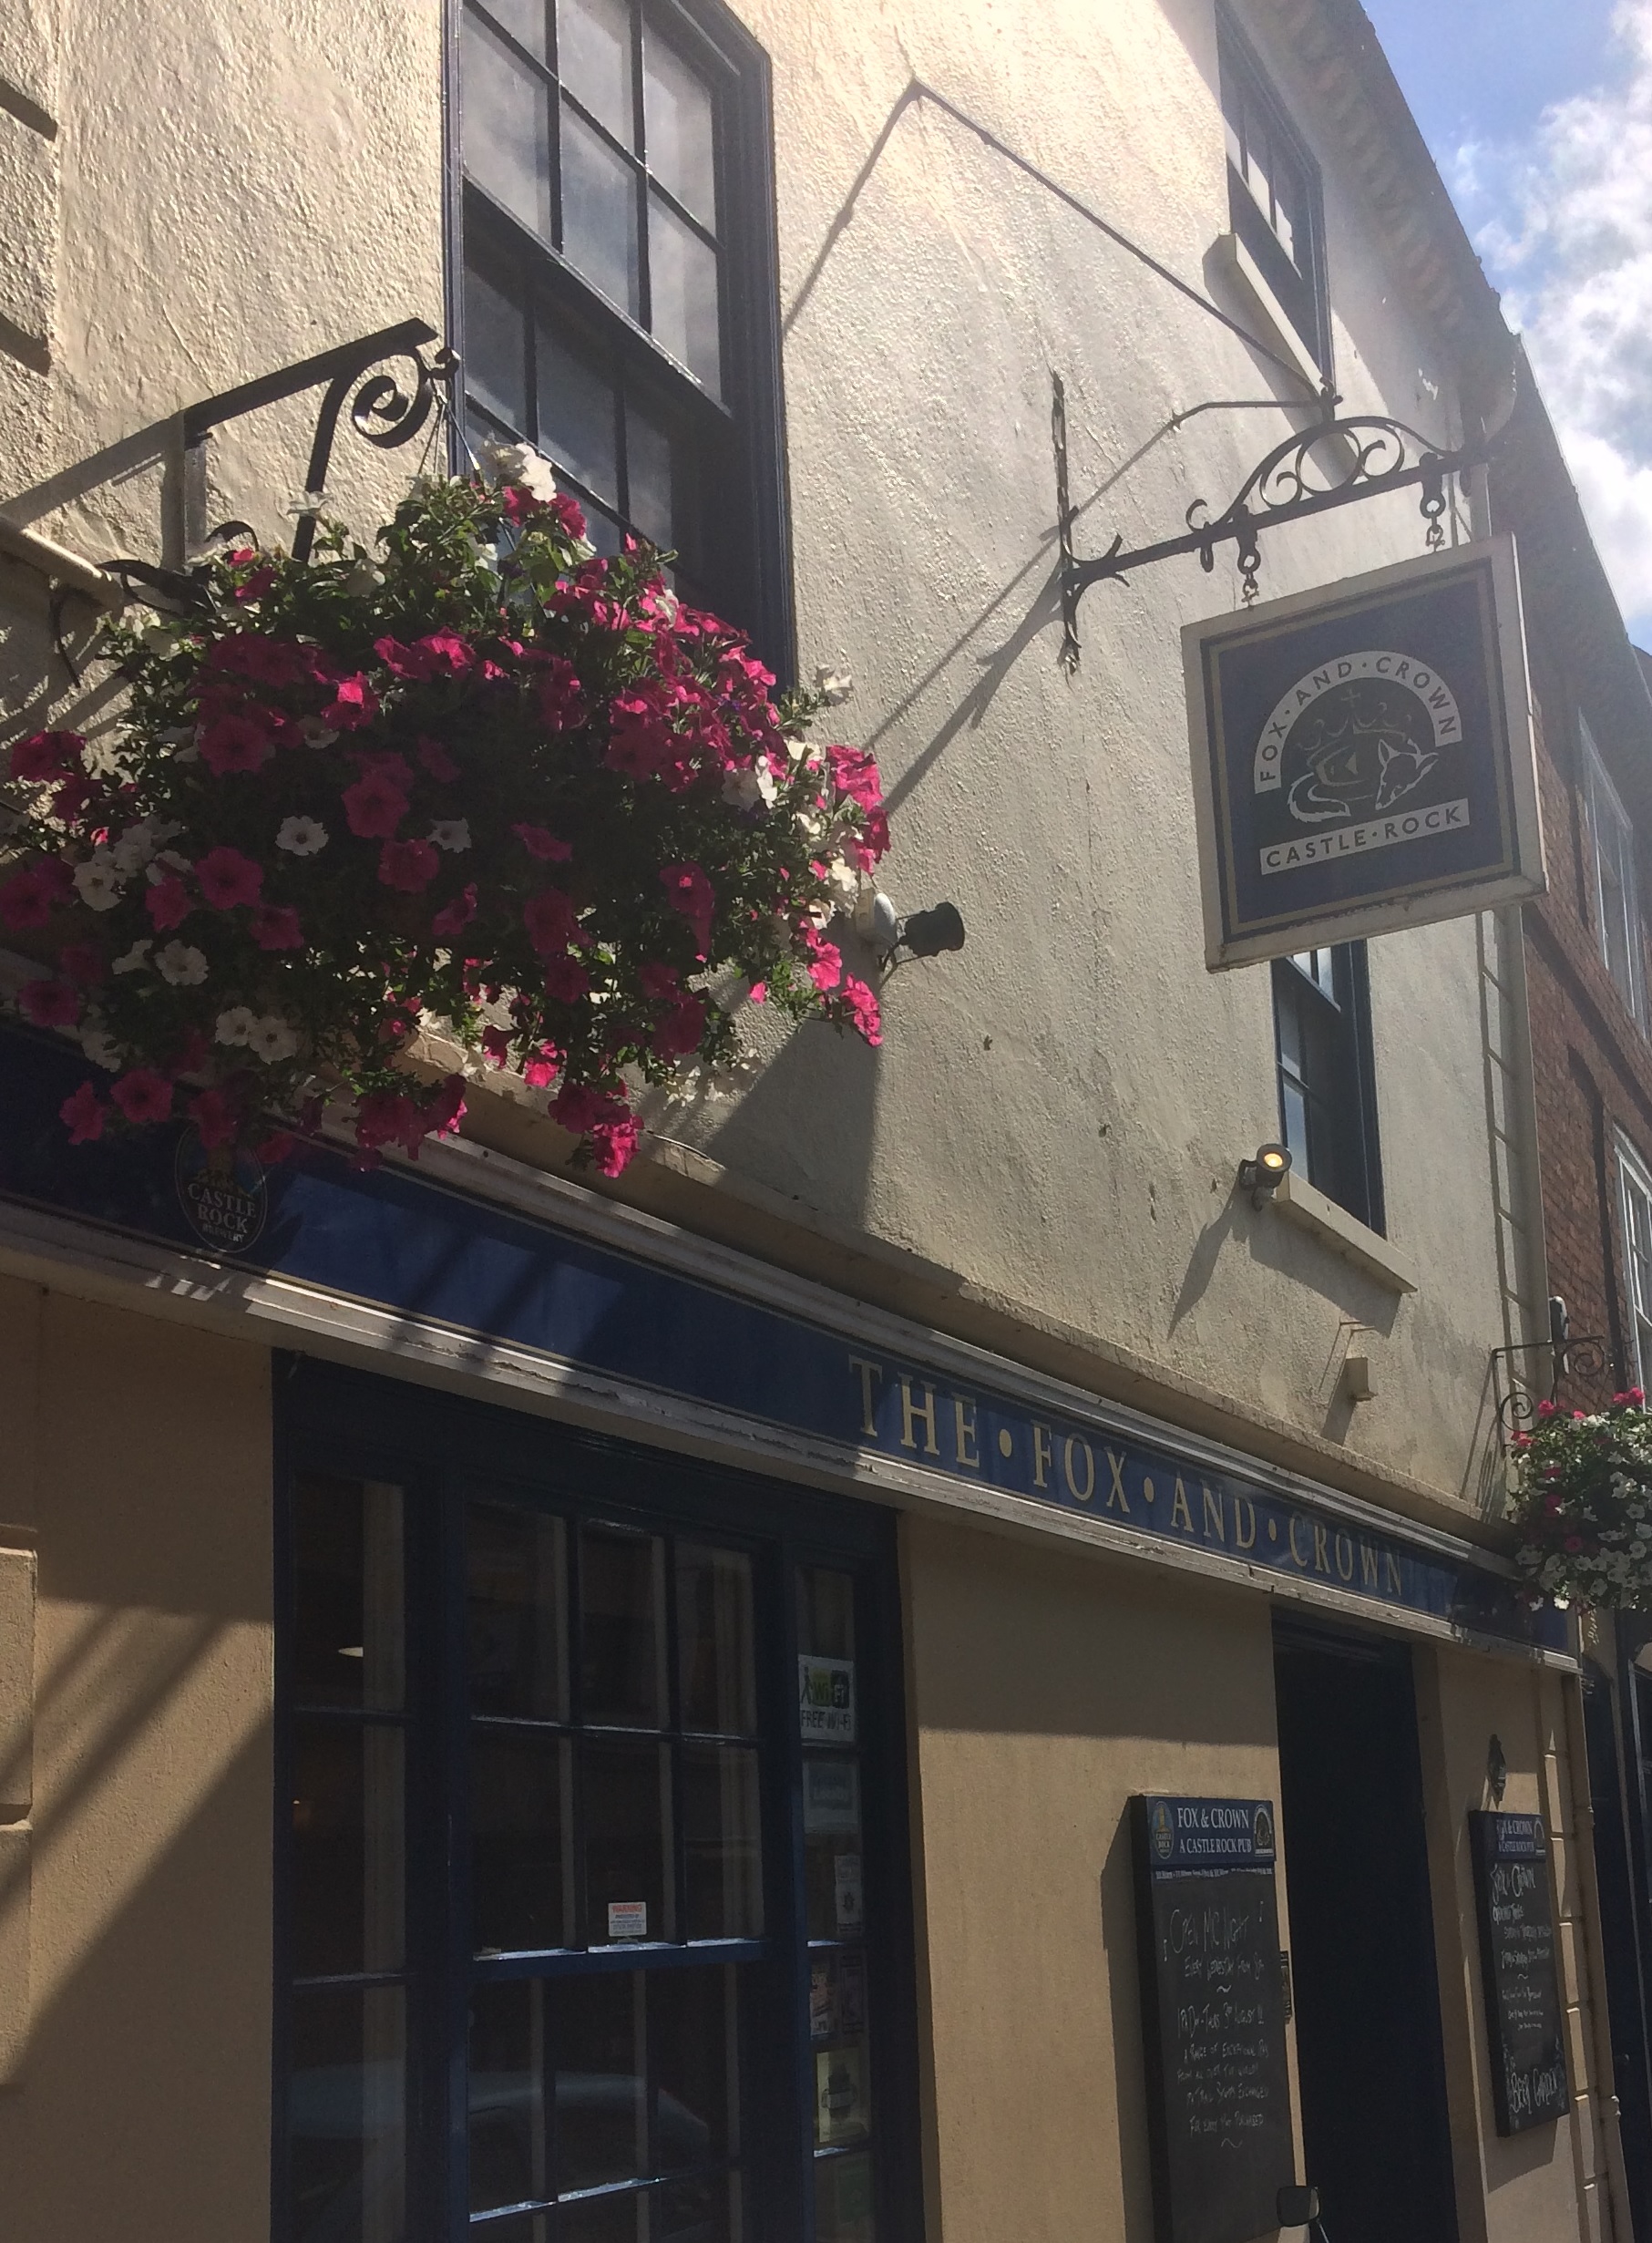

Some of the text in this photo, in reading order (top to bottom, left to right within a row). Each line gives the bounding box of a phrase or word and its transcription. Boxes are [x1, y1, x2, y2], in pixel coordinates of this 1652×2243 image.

[1259, 655, 1457, 784] FOX AND CROWN
[1265, 805, 1462, 869] CASTLE ROCK
[187, 1182, 257, 1219] CASTLE
[197, 1203, 248, 1234] ROCK
[848, 1354, 1404, 1598] THE FOX AND CROWN
[801, 1710, 825, 1729] FREE
[1177, 1807, 1249, 1829] FOX & CROWN
[1179, 1839, 1186, 1854] A
[1186, 1837, 1216, 1854] CASTLE
[1216, 1838, 1238, 1854] ROCK
[1237, 1837, 1252, 1854] PUB
